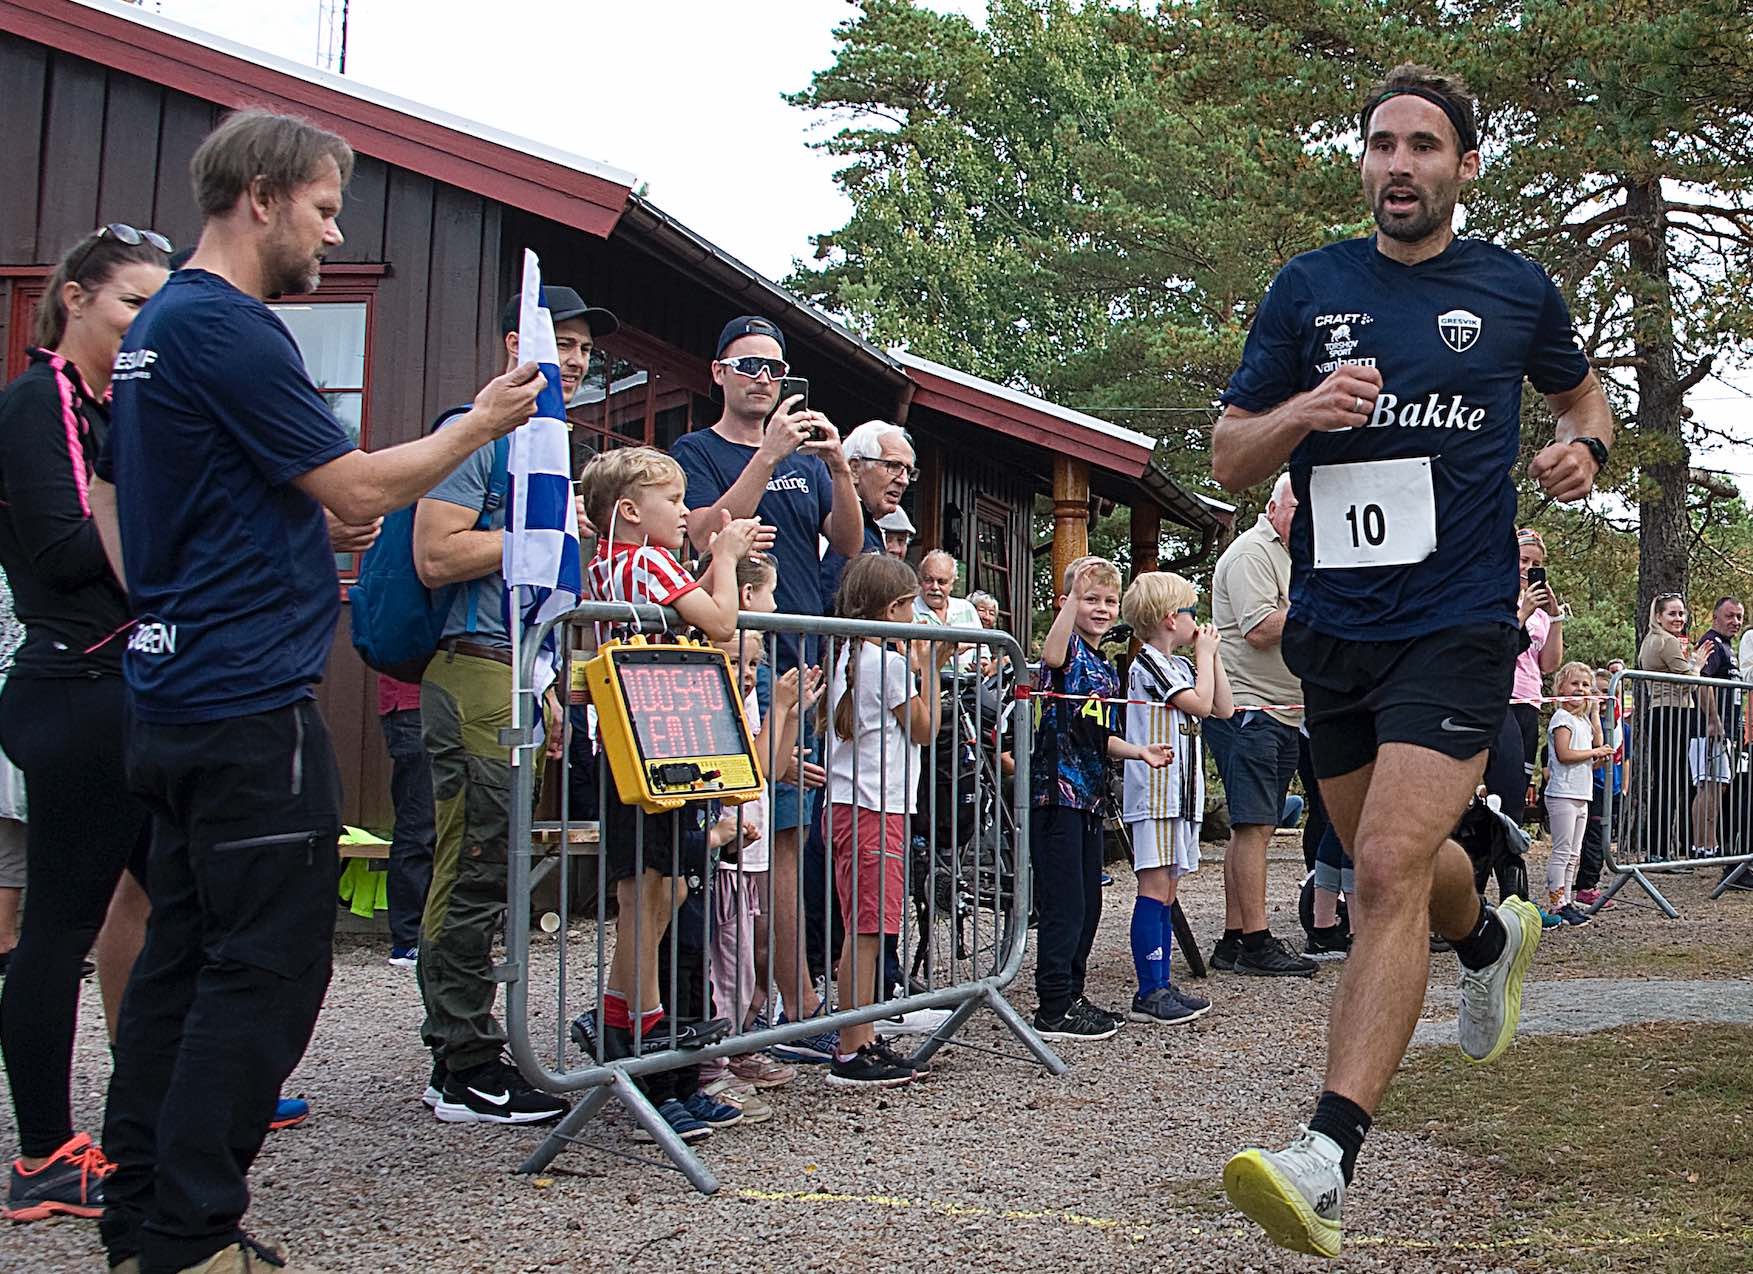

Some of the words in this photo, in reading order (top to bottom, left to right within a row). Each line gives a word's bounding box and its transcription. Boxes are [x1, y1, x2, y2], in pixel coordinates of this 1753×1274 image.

[1315, 314, 1361, 327] CRAFT
[1441, 318, 1478, 326] GRESVIK
[1329, 347, 1352, 358] SPORT
[1366, 393, 1486, 431] Bakke
[1345, 503, 1386, 548] 10
[649, 714, 716, 758] EMIT
